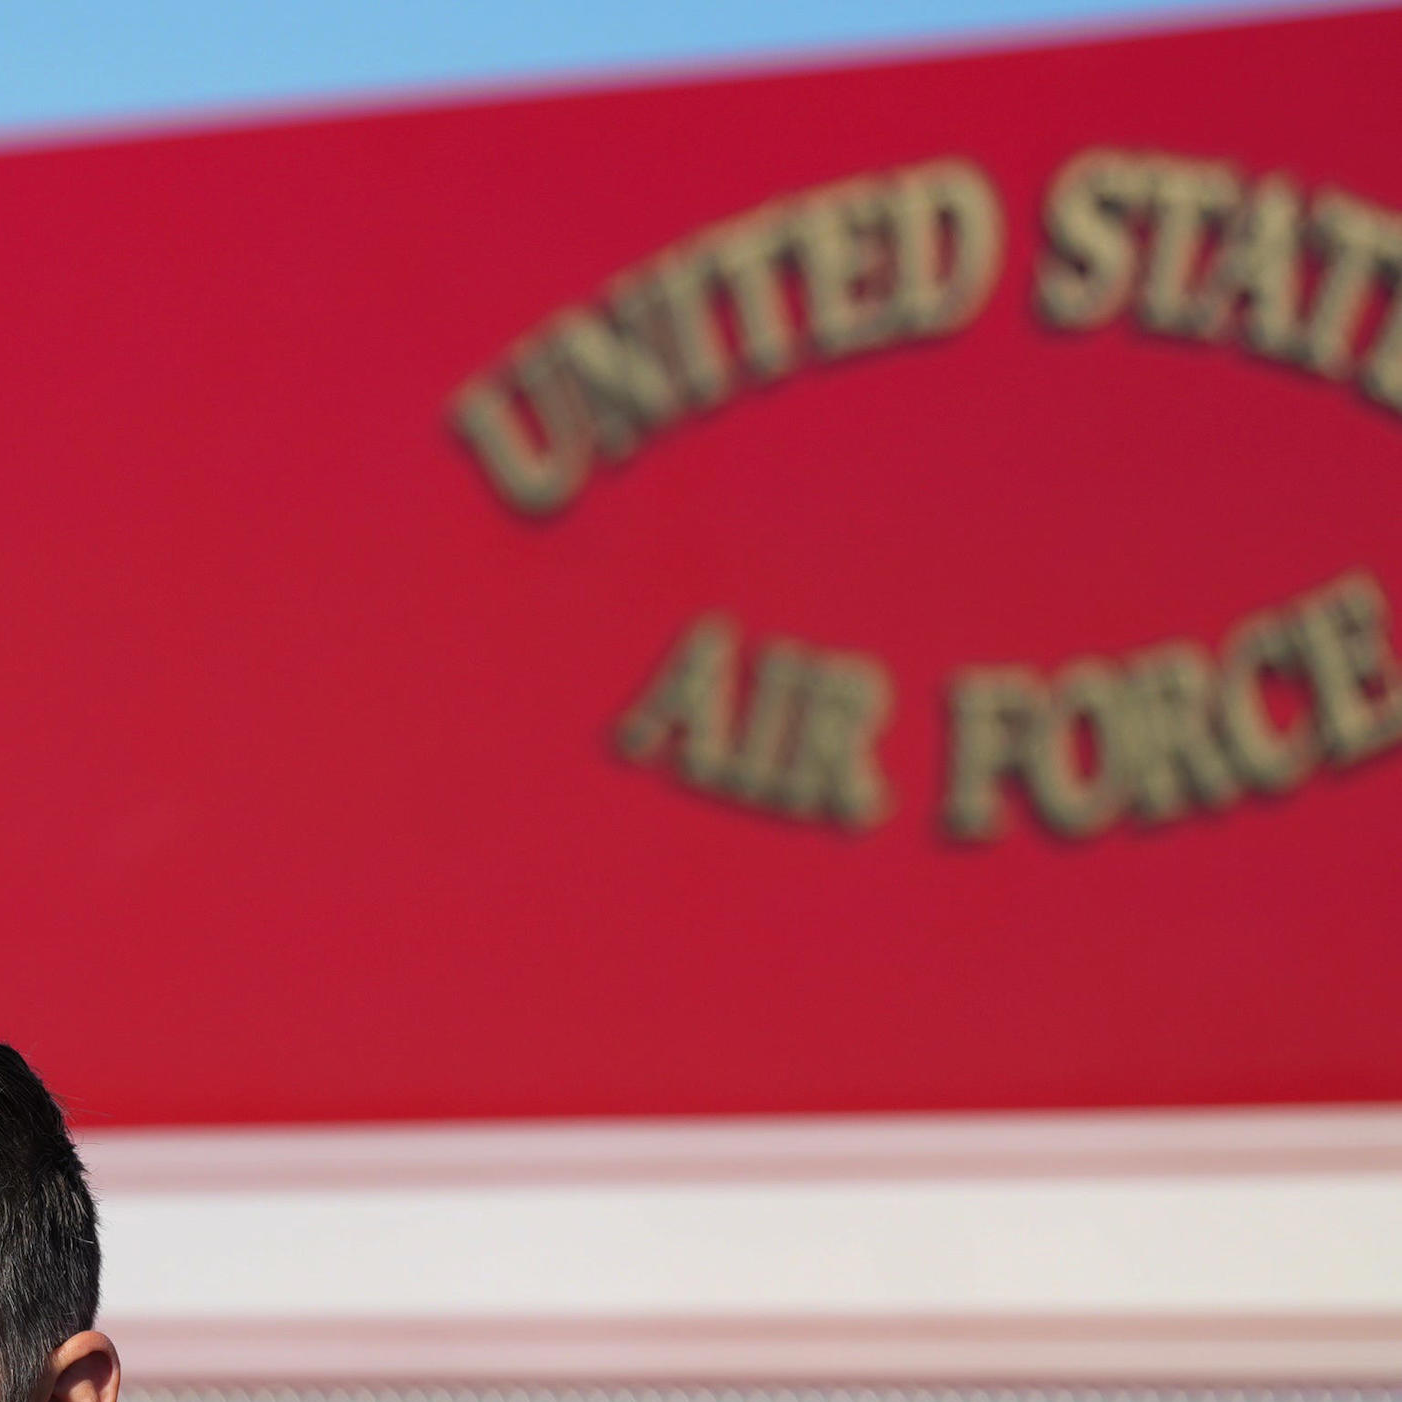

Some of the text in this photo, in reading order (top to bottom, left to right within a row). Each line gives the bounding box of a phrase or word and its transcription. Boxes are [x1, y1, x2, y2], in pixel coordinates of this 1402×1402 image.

[449, 154, 1004, 520] UNITED
[614, 568, 1402, 848] AIR FORCE
